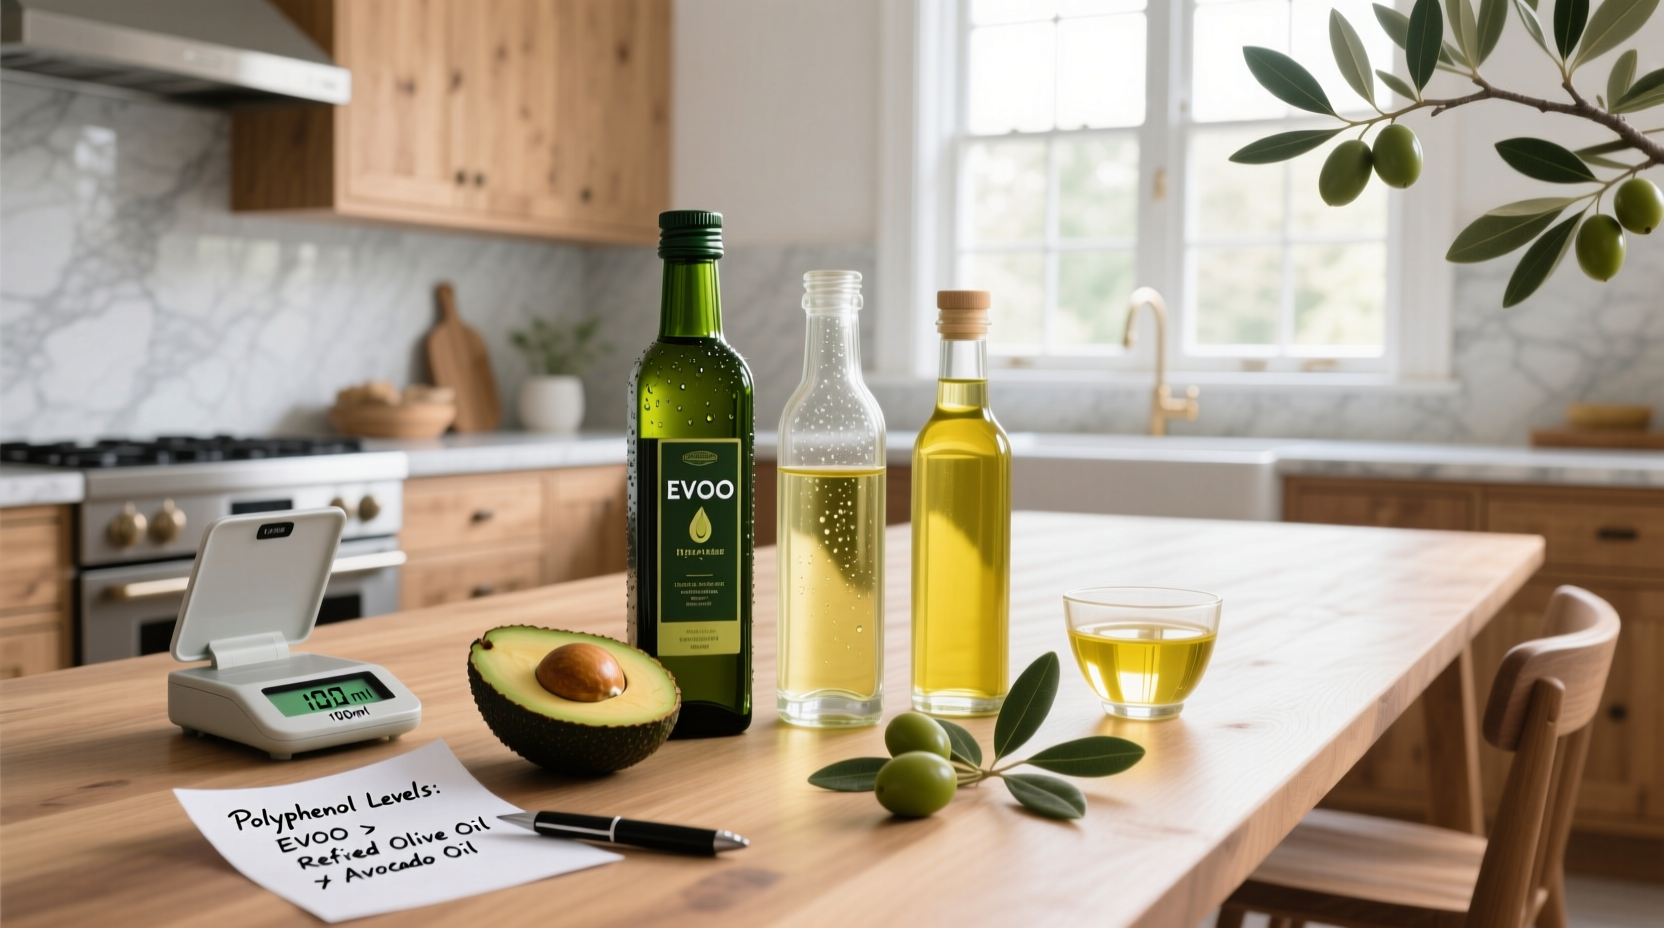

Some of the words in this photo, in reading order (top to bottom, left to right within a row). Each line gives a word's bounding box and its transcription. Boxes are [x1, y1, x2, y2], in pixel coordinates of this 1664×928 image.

[667, 479, 735, 500] EVOO
[302, 686, 351, 711] 100
[350, 687, 374, 702] ml
[227, 795, 357, 835] Polyphenol
[365, 780, 442, 810] Levels:
[276, 827, 349, 854] EVOO
[389, 829, 449, 851] Olive
[454, 815, 491, 837] Oil
[345, 852, 436, 884] Avocado
[443, 840, 479, 859] Oil
